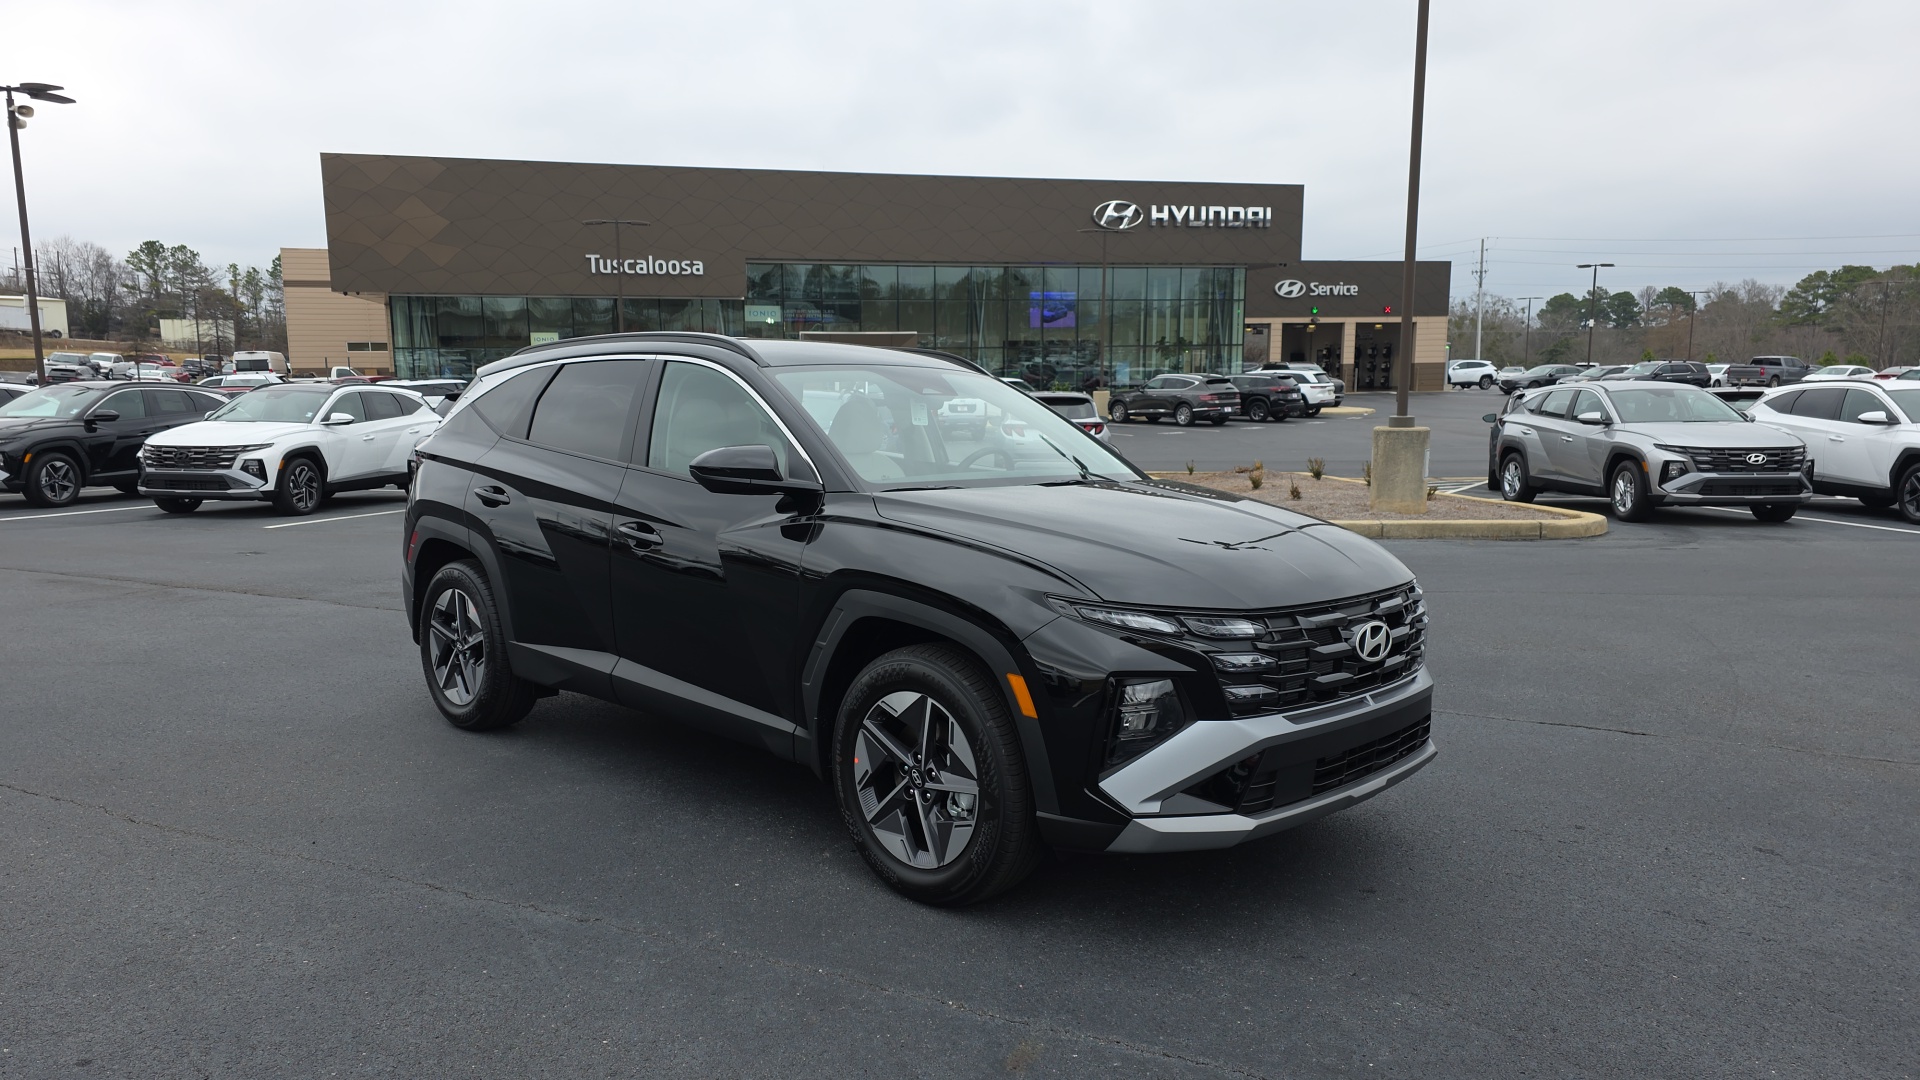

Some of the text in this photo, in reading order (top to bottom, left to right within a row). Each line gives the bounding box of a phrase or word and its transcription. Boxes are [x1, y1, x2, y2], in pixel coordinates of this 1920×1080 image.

[1151, 205, 1272, 227] HYUNDAI
[585, 254, 704, 275] Tuscaloosa
[1309, 282, 1359, 296] Service
